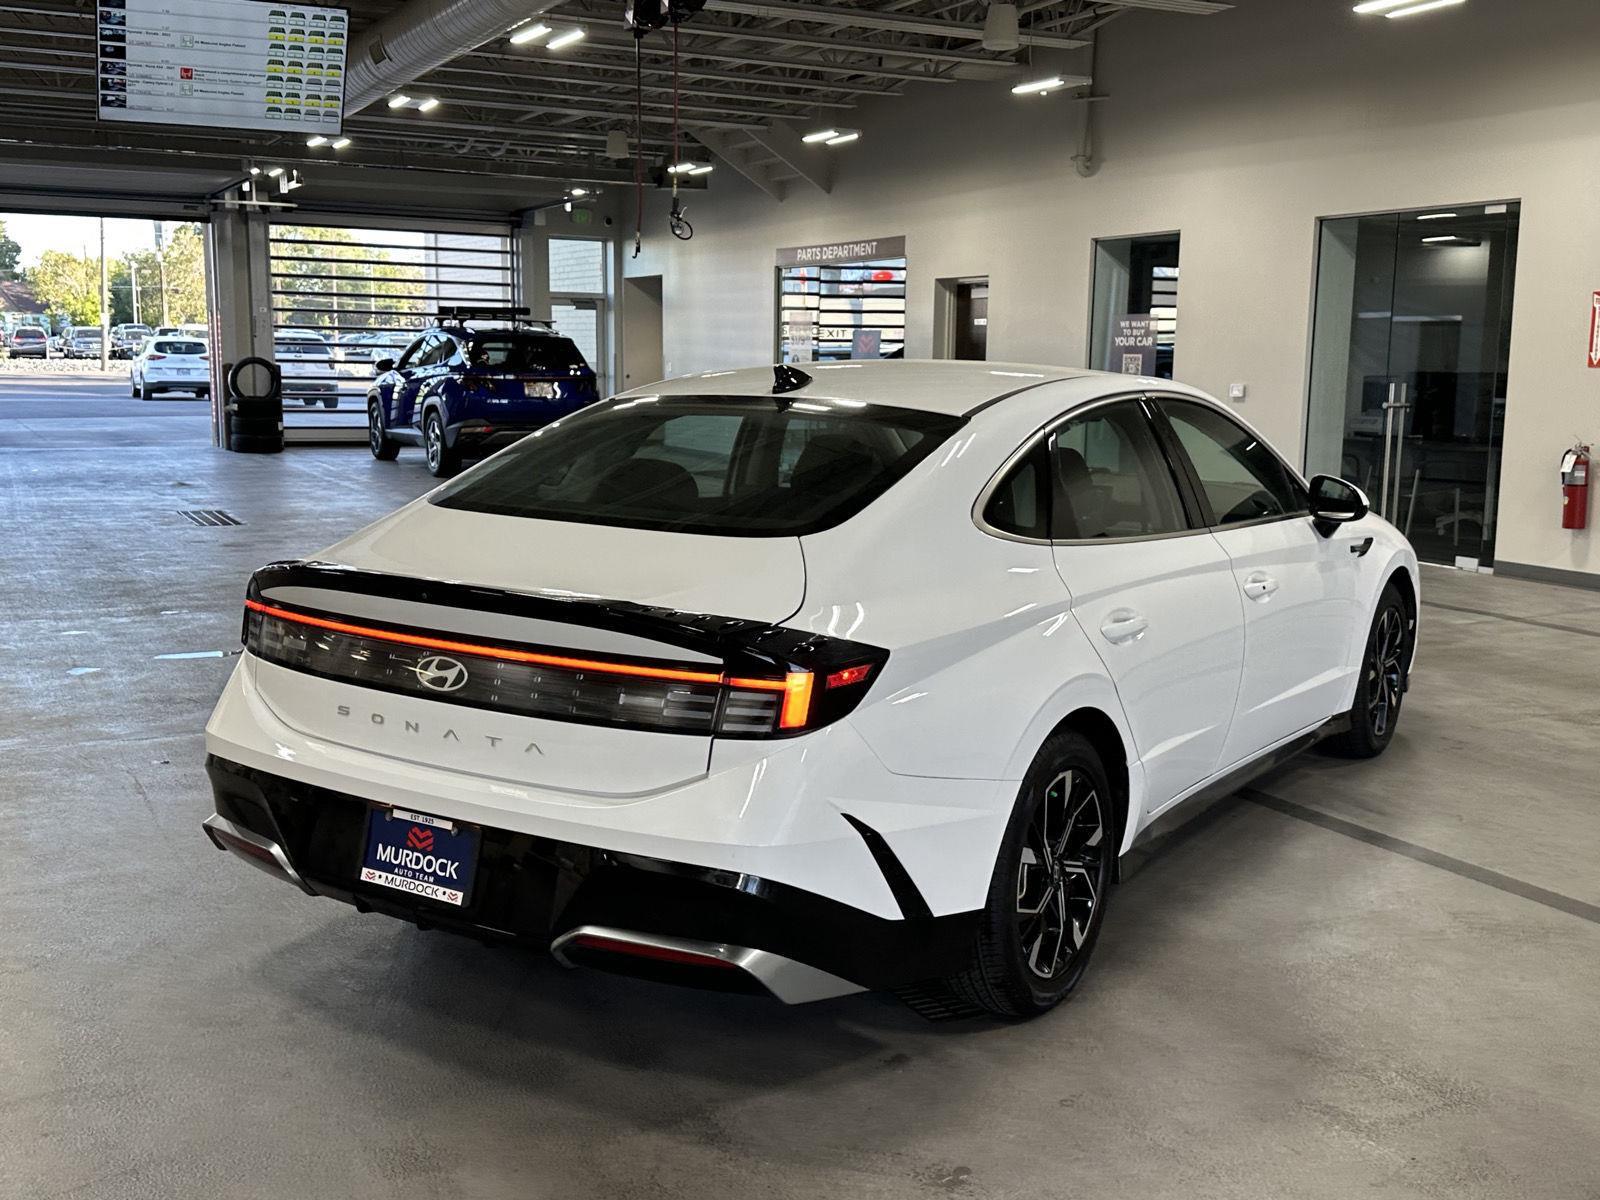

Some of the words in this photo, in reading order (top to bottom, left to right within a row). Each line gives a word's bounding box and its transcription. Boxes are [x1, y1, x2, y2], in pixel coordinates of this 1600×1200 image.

[797, 248, 821, 261] PARTS
[822, 242, 877, 259] DEPARTMENT
[1120, 320, 1130, 328] WE
[1131, 320, 1150, 328] WANT
[819, 328, 847, 338] EXIT
[1115, 337, 1135, 346] YOUR
[1136, 336, 1153, 346] CAR
[337, 704, 544, 755] SONATA
[422, 815, 434, 824] 1925
[376, 843, 459, 880] MURDOCK
[394, 867, 413, 878] AUTO
[415, 873, 434, 883] TEAM
[384, 875, 440, 898] MURDOCK
